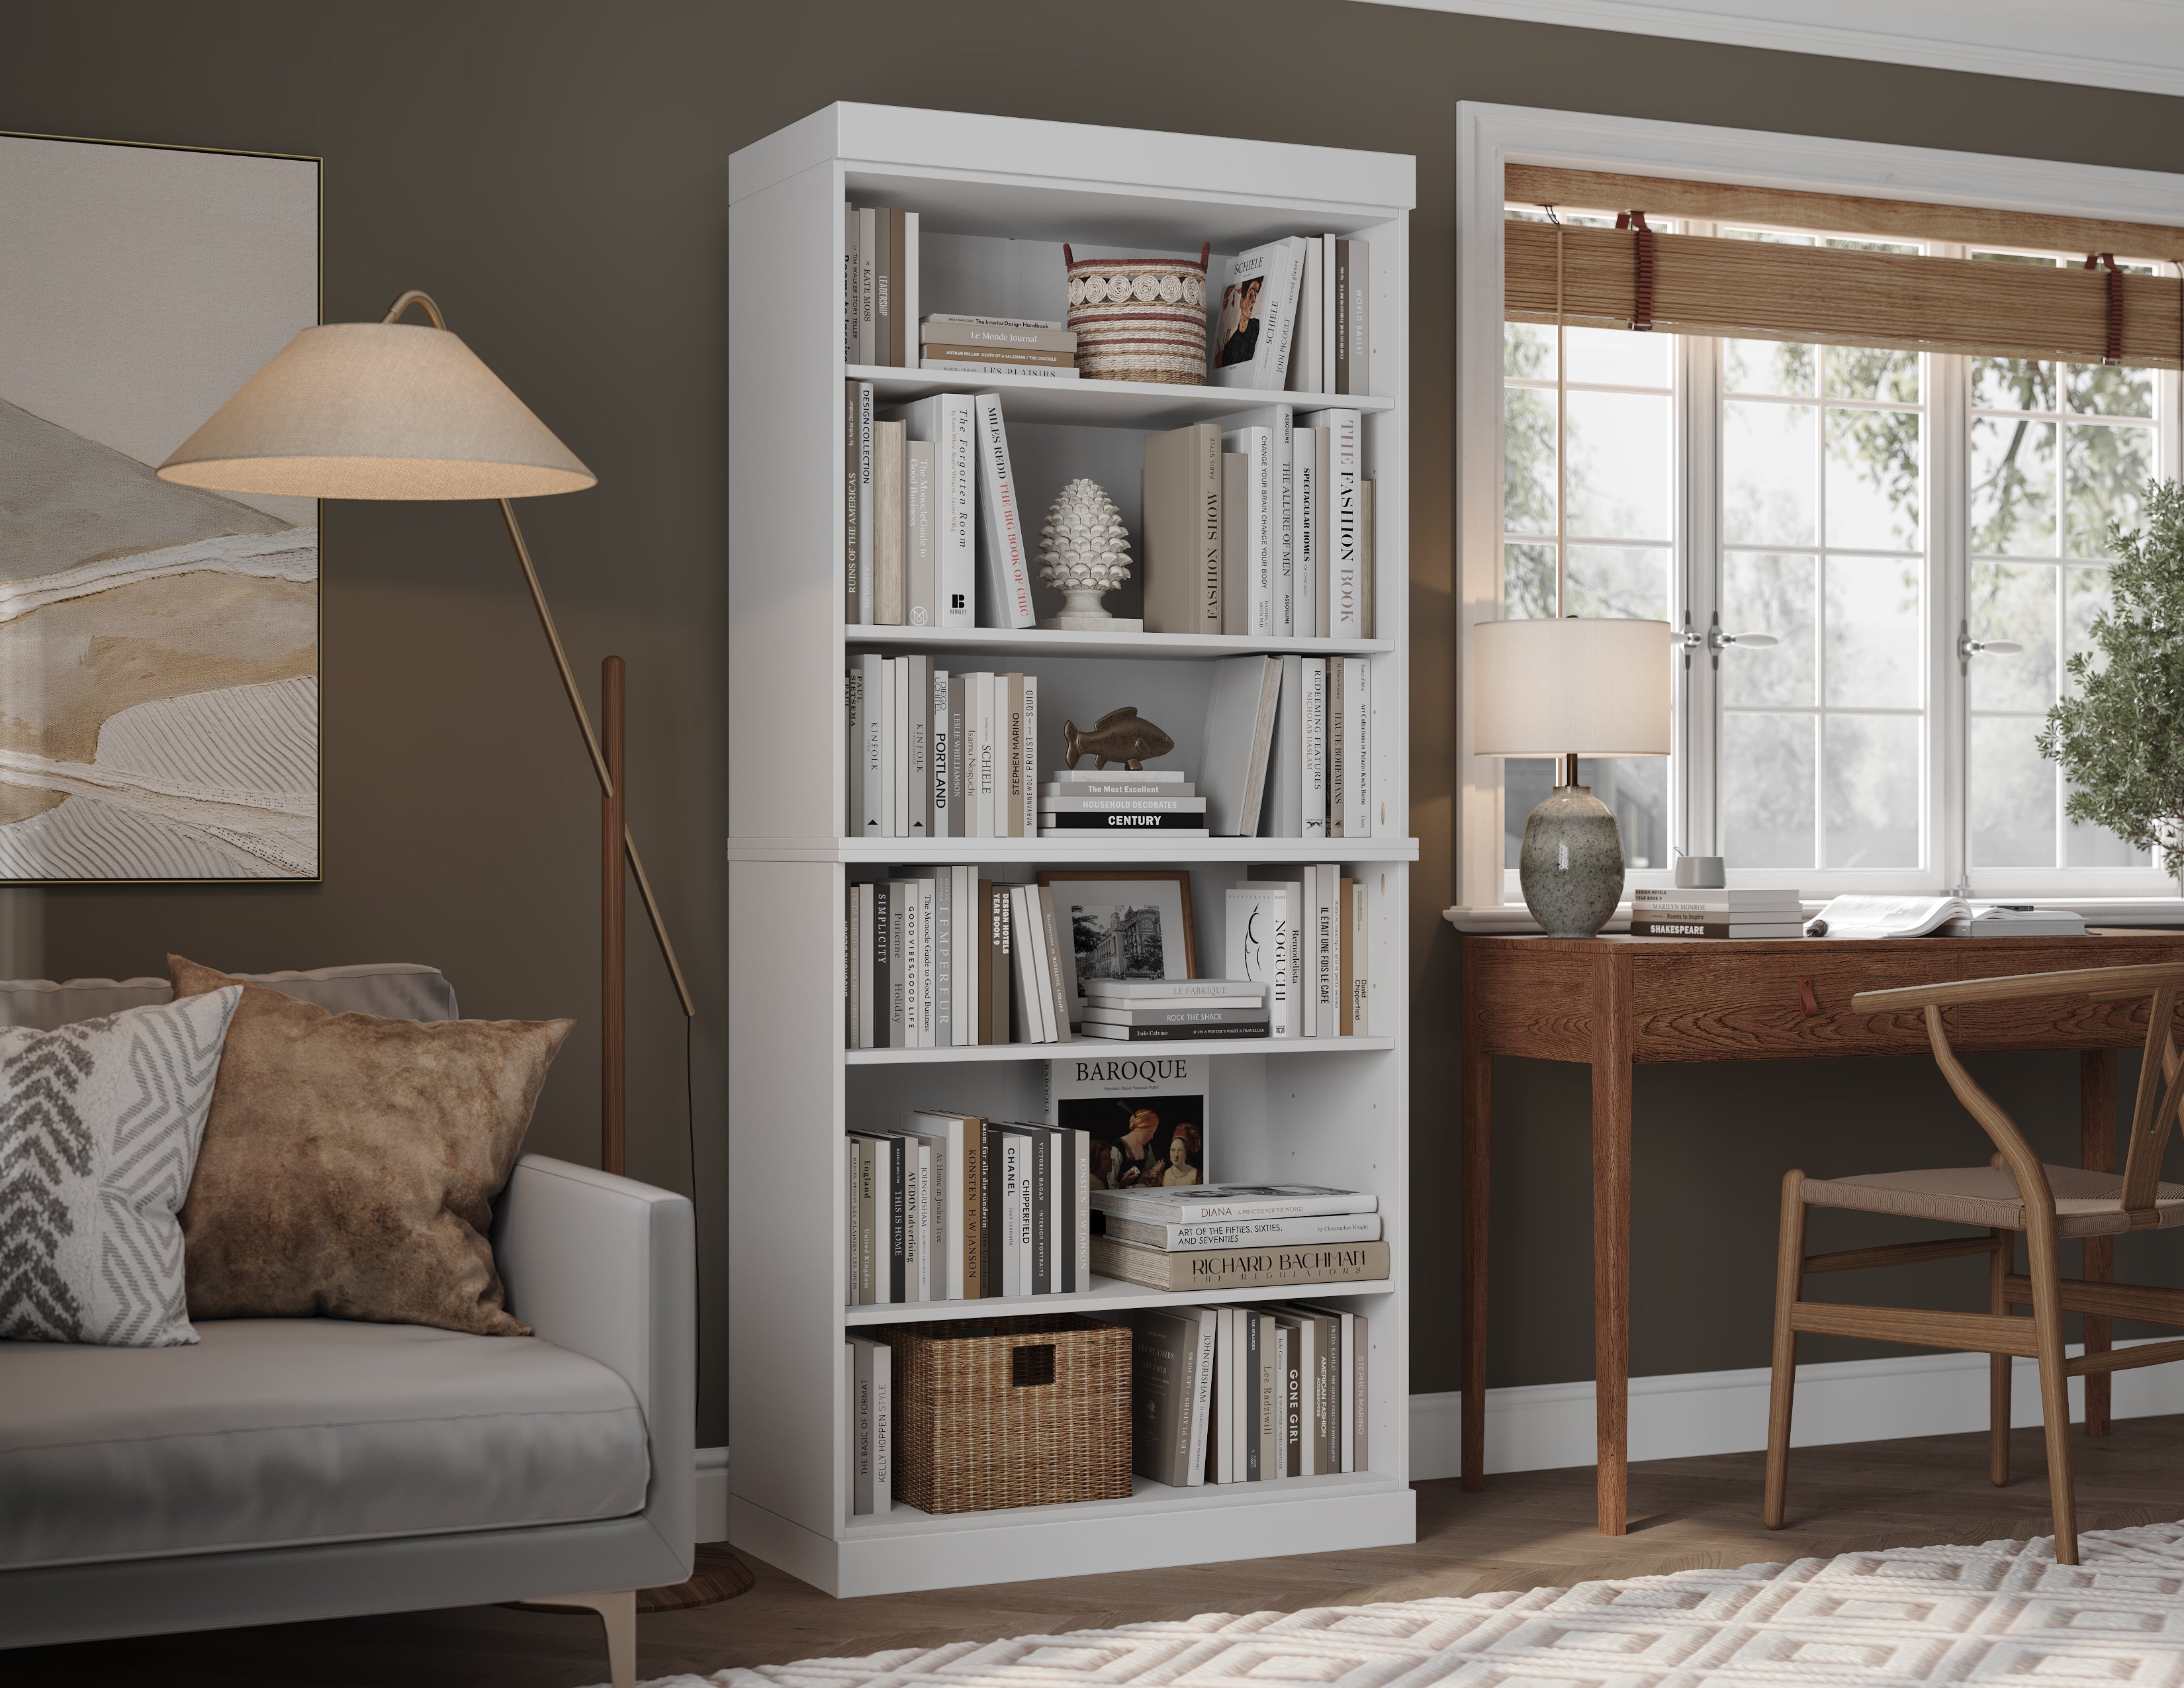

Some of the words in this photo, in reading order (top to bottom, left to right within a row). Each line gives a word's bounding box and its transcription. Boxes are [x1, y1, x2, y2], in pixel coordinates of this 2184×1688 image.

[1234, 256, 1264, 275] SCHIELE
[879, 276, 887, 316] LEADERSHIP
[1355, 290, 1364, 322] WORLD
[982, 332, 1008, 341] Monde
[1010, 334, 1037, 343] Journal
[1265, 301, 1279, 344] SCHIELE
[1280, 318, 1291, 353] PICOULT
[1355, 326, 1364, 356] BALLET
[959, 410, 968, 433] The
[987, 407, 1001, 444] MILES
[1341, 420, 1353, 465] THE
[909, 459, 918, 483] Good
[957, 439, 968, 505] Forgotten
[993, 447, 1007, 479] REDD
[909, 487, 918, 526] Business
[1000, 482, 1011, 507] THE
[1003, 510, 1015, 530] BIG
[1207, 490, 1218, 539] SHOW
[1341, 469, 1353, 561] FASHION
[959, 512, 968, 548] Room
[1283, 534, 1291, 549] OF
[848, 547, 856, 562] OF
[1007, 534, 1021, 566] BOOK
[1013, 569, 1023, 585] OF
[1207, 547, 1218, 620] FASHION
[1017, 588, 1028, 617] CHIC
[1341, 567, 1353, 624] BOOK
[936, 733, 946, 808] PORTLAND
[966, 758, 976, 796] Noguchi
[981, 745, 991, 794] SCHIELE
[1132, 800, 1177, 809] DECORATES
[1108, 816, 1161, 825] CENTURY
[1320, 916, 1331, 937] ÉTAIT
[1651, 924, 1704, 935] SHAKESPEARE
[1275, 919, 1286, 1002] NOGUCHI
[1320, 939, 1329, 954] UNE
[1320, 955, 1329, 972] FOIS
[1320, 974, 1329, 983] LE
[891, 984, 903, 1023] Holiday
[1320, 985, 1331, 1004] CAFÉ
[1075, 1060, 1187, 1082] BAROQUE
[862, 1160, 871, 1199] England
[1201, 1207, 1232, 1218] DIANA
[907, 1214, 916, 1263] advertising
[1178, 1237, 1197, 1246] AND
[1199, 1235, 1239, 1244] SEVENTIES
[1192, 1254, 1273, 1275] RICHARD
[1280, 1250, 1365, 1270] BACHMAN
[1289, 1369, 1298, 1408] GONE
[861, 1417, 868, 1429] OF
[1289, 1414, 1298, 1444] GIRL
